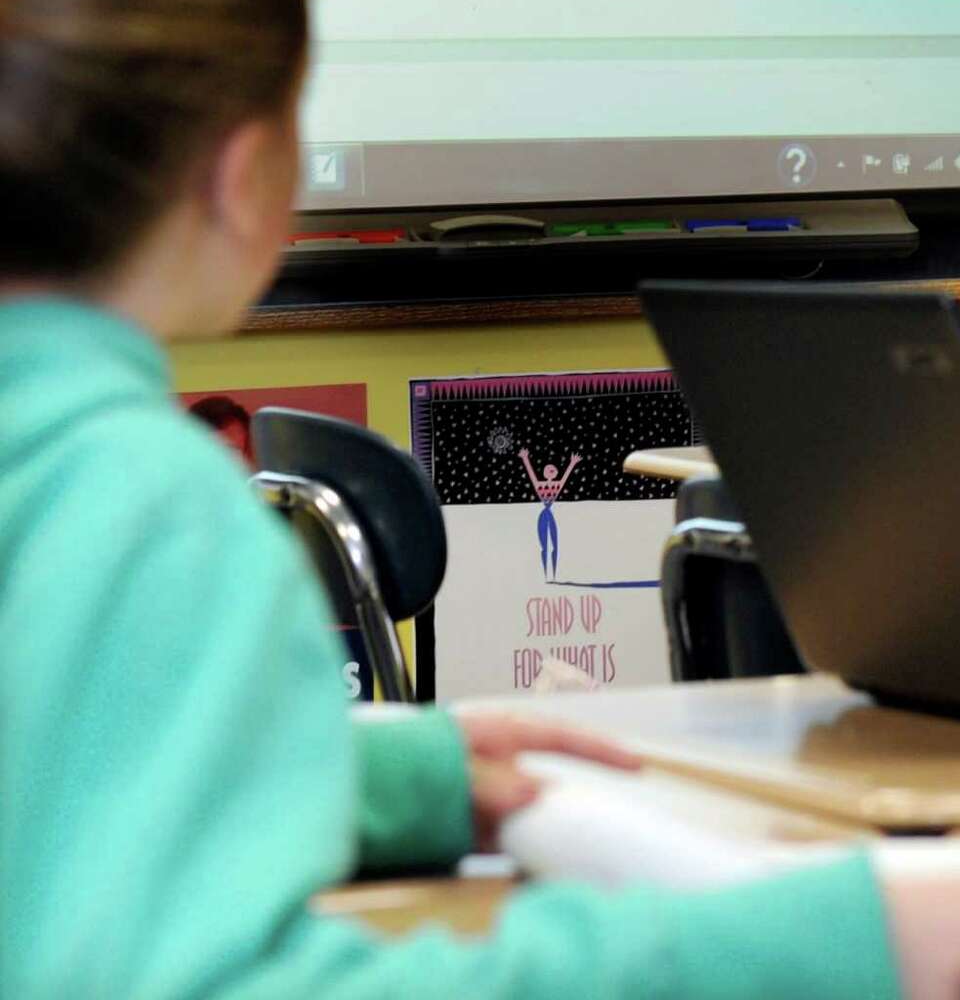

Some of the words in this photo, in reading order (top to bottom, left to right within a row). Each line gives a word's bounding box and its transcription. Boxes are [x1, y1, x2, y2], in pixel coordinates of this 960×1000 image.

[526, 595, 574, 637] STAND
[580, 593, 602, 634] UP
[603, 643, 617, 684] IS
